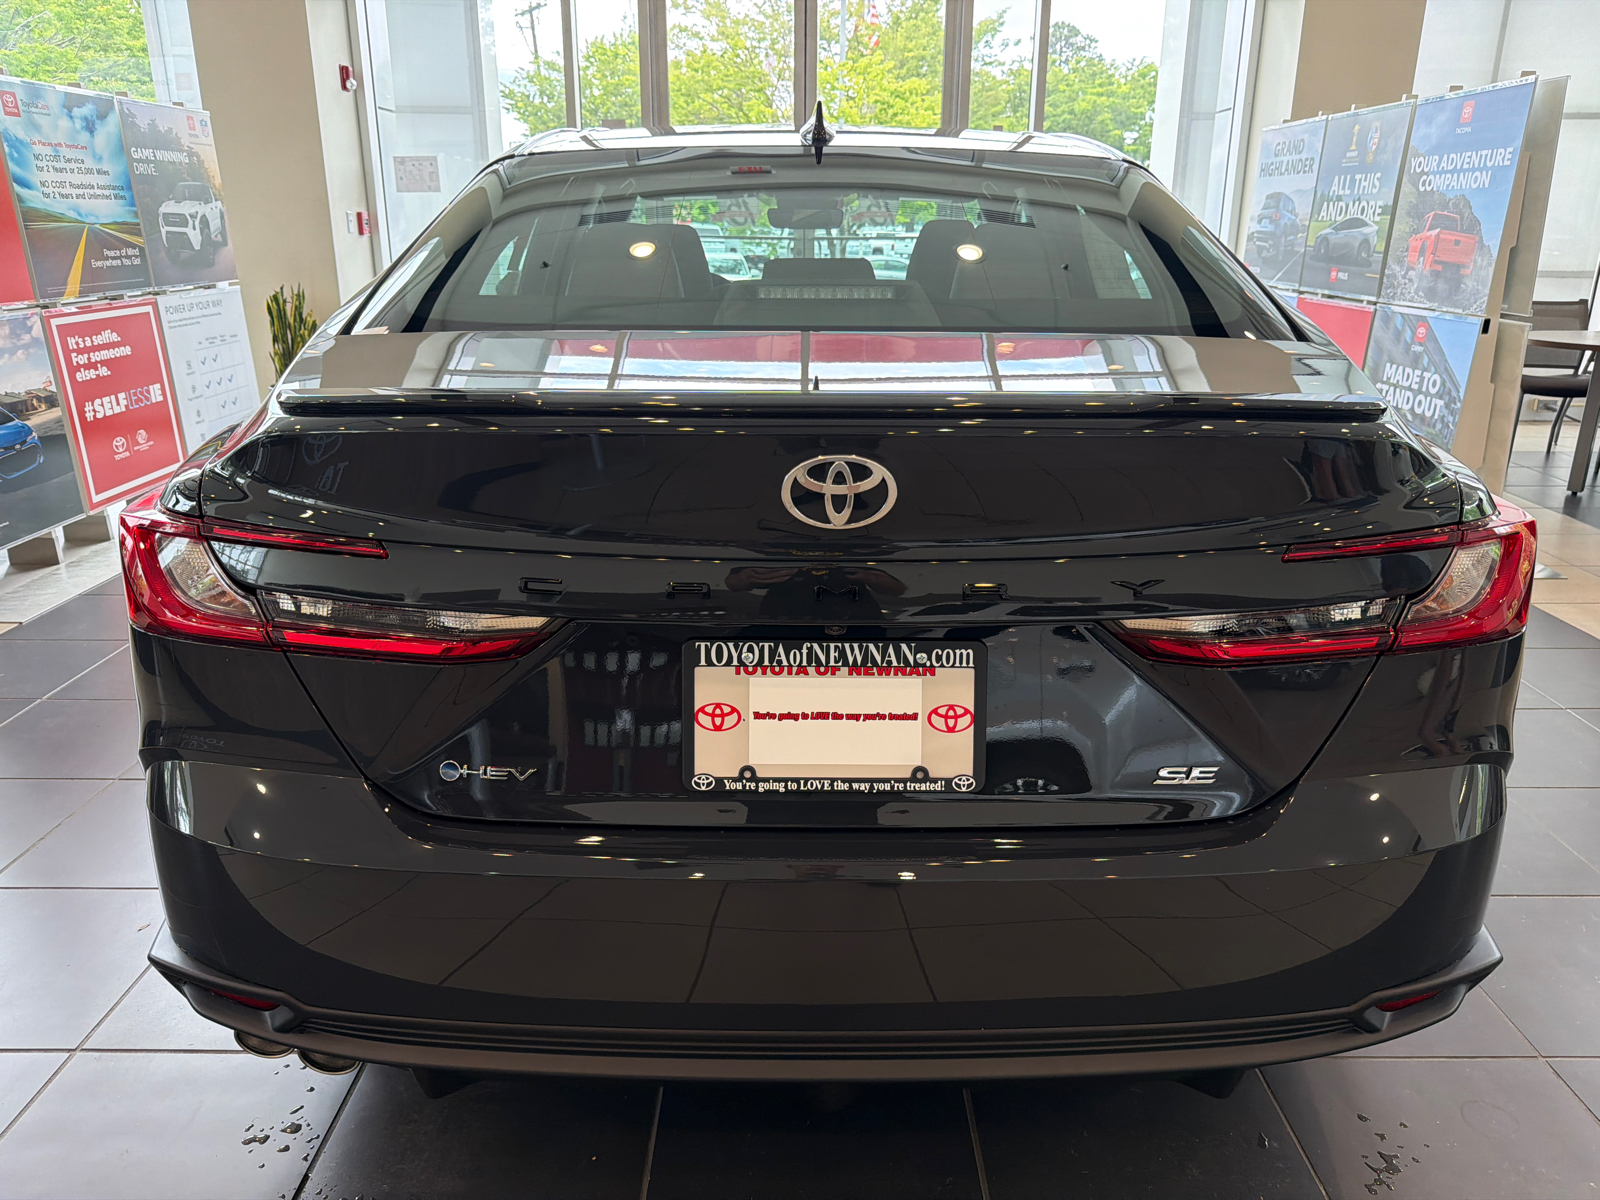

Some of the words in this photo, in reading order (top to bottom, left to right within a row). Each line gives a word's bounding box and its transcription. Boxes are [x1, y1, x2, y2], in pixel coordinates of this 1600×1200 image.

[20, 99, 50, 110] ToyotaCare
[1456, 126, 1472, 134] TACOMA
[37, 140, 53, 148] Places
[64, 142, 88, 150] ToyotaCare
[1274, 139, 1305, 158] GRAND
[33, 153, 43, 162] NO
[45, 154, 61, 163] COST
[63, 155, 85, 164] Service
[131, 147, 154, 160] GAME
[154, 149, 189, 162] WINNING
[1411, 155, 1439, 173] YOUR
[1439, 147, 1513, 171] ADVENTURE
[36, 164, 44, 172] for
[46, 165, 50, 173] 2
[51, 165, 68, 174] Years
[76, 166, 95, 176] 25,000
[96, 168, 110, 176] Miles
[133, 162, 158, 175] DRIVE.
[1259, 157, 1315, 178] HIGHLANDER
[39, 180, 49, 189] NO
[51, 180, 67, 190] COST
[69, 181, 95, 191] Roadside
[97, 182, 124, 191] Assistance
[1330, 175, 1351, 195] ALL
[1354, 172, 1381, 195] THIS
[1419, 171, 1491, 191] COMPANION
[42, 190, 50, 199] for
[52, 191, 56, 199] 2
[57, 191, 74, 200] Years
[75, 192, 86, 200] and
[87, 192, 112, 200] Unlimited
[113, 192, 127, 201] Miles
[1319, 202, 1346, 221] AND
[1347, 200, 1383, 221] MORE
[103, 248, 120, 257] Peace
[121, 248, 126, 256] of
[126, 247, 139, 256] Mind
[91, 258, 121, 269] Everywhere
[132, 257, 141, 265] Go!
[165, 304, 186, 315] POWER
[187, 303, 195, 312] UP
[195, 300, 211, 310] YOUR
[212, 299, 222, 308] WAY
[67, 335, 84, 350] It's
[84, 337, 92, 347] a
[92, 329, 121, 345] selfie.
[71, 352, 89, 366] For
[90, 345, 132, 362] someone
[76, 363, 111, 382] else-ie.
[1383, 362, 1422, 390] MADE
[1422, 371, 1441, 394] TO
[84, 383, 163, 422] #SELFLESSIE
[1414, 394, 1444, 419] OUT
[114, 451, 130, 461] TOYOTA
[518, 576, 1166, 601] CAMRY
[695, 641, 975, 667] TOYOTAofNEWNAN.com
[735, 666, 809, 676] TOYOTA
[814, 666, 841, 676] OF
[848, 666, 936, 676] NEWNAN
[753, 711, 777, 720] You're
[778, 711, 800, 722] going
[801, 712, 810, 720] to
[810, 712, 830, 720] LOVE
[831, 712, 844, 720] the
[845, 713, 862, 722] way
[862, 712, 887, 722] you're
[888, 712, 918, 721] treated!
[460, 764, 538, 782] HEV
[1152, 766, 1220, 785] SE
[723, 779, 756, 790] You're
[758, 780, 786, 792] going
[787, 781, 798, 790] to
[799, 780, 831, 790] LOVE
[833, 780, 850, 790] the
[852, 782, 871, 793] way
[872, 780, 904, 793] you're
[906, 780, 945, 791] treated!
